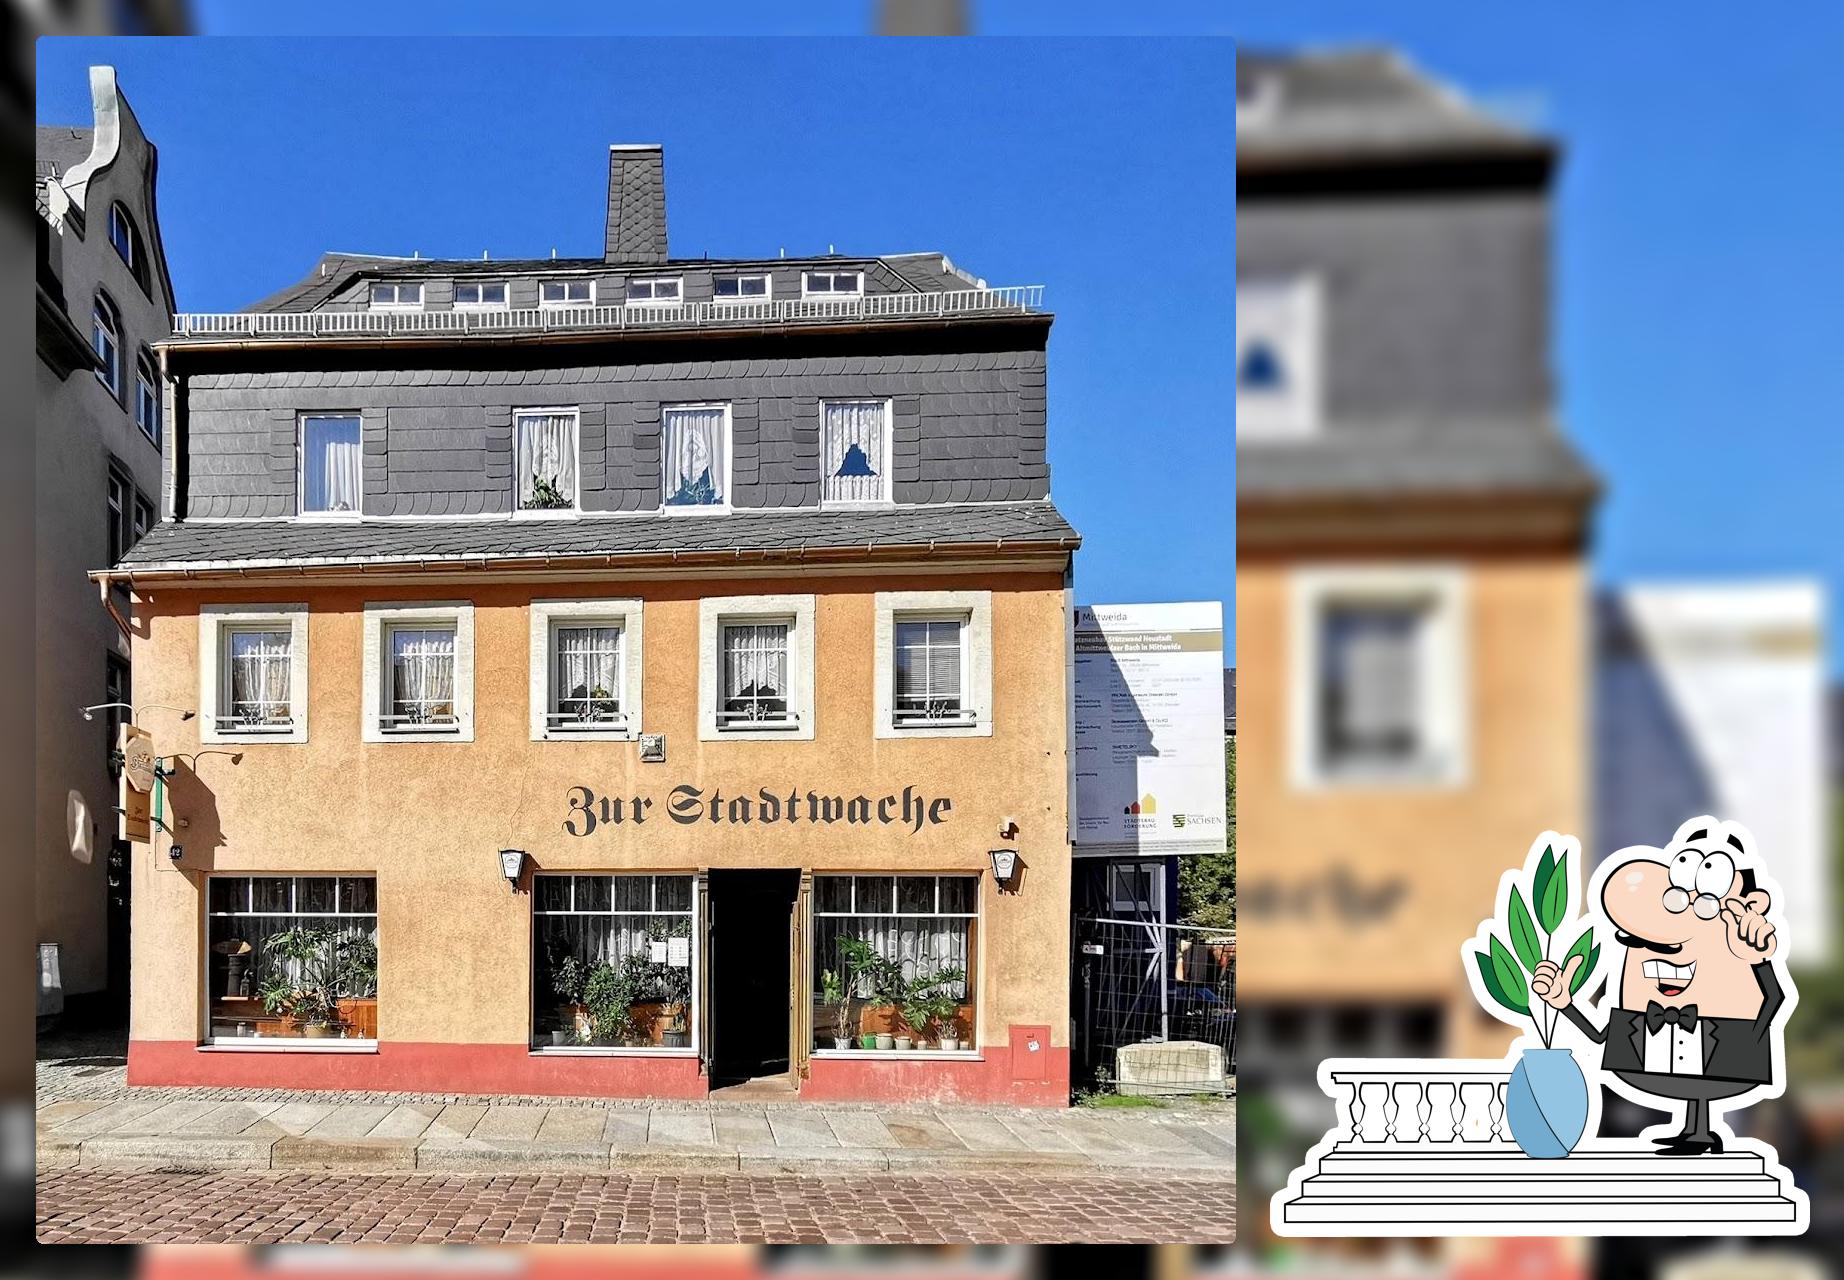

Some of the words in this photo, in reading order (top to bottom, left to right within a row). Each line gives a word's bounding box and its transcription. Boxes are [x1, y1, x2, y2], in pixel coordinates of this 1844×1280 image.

[1082, 613, 1128, 621] Mittweida
[561, 786, 653, 837] Zur
[666, 784, 952, 837] Stadtwache
[1187, 817, 1222, 825] SACHSEN
